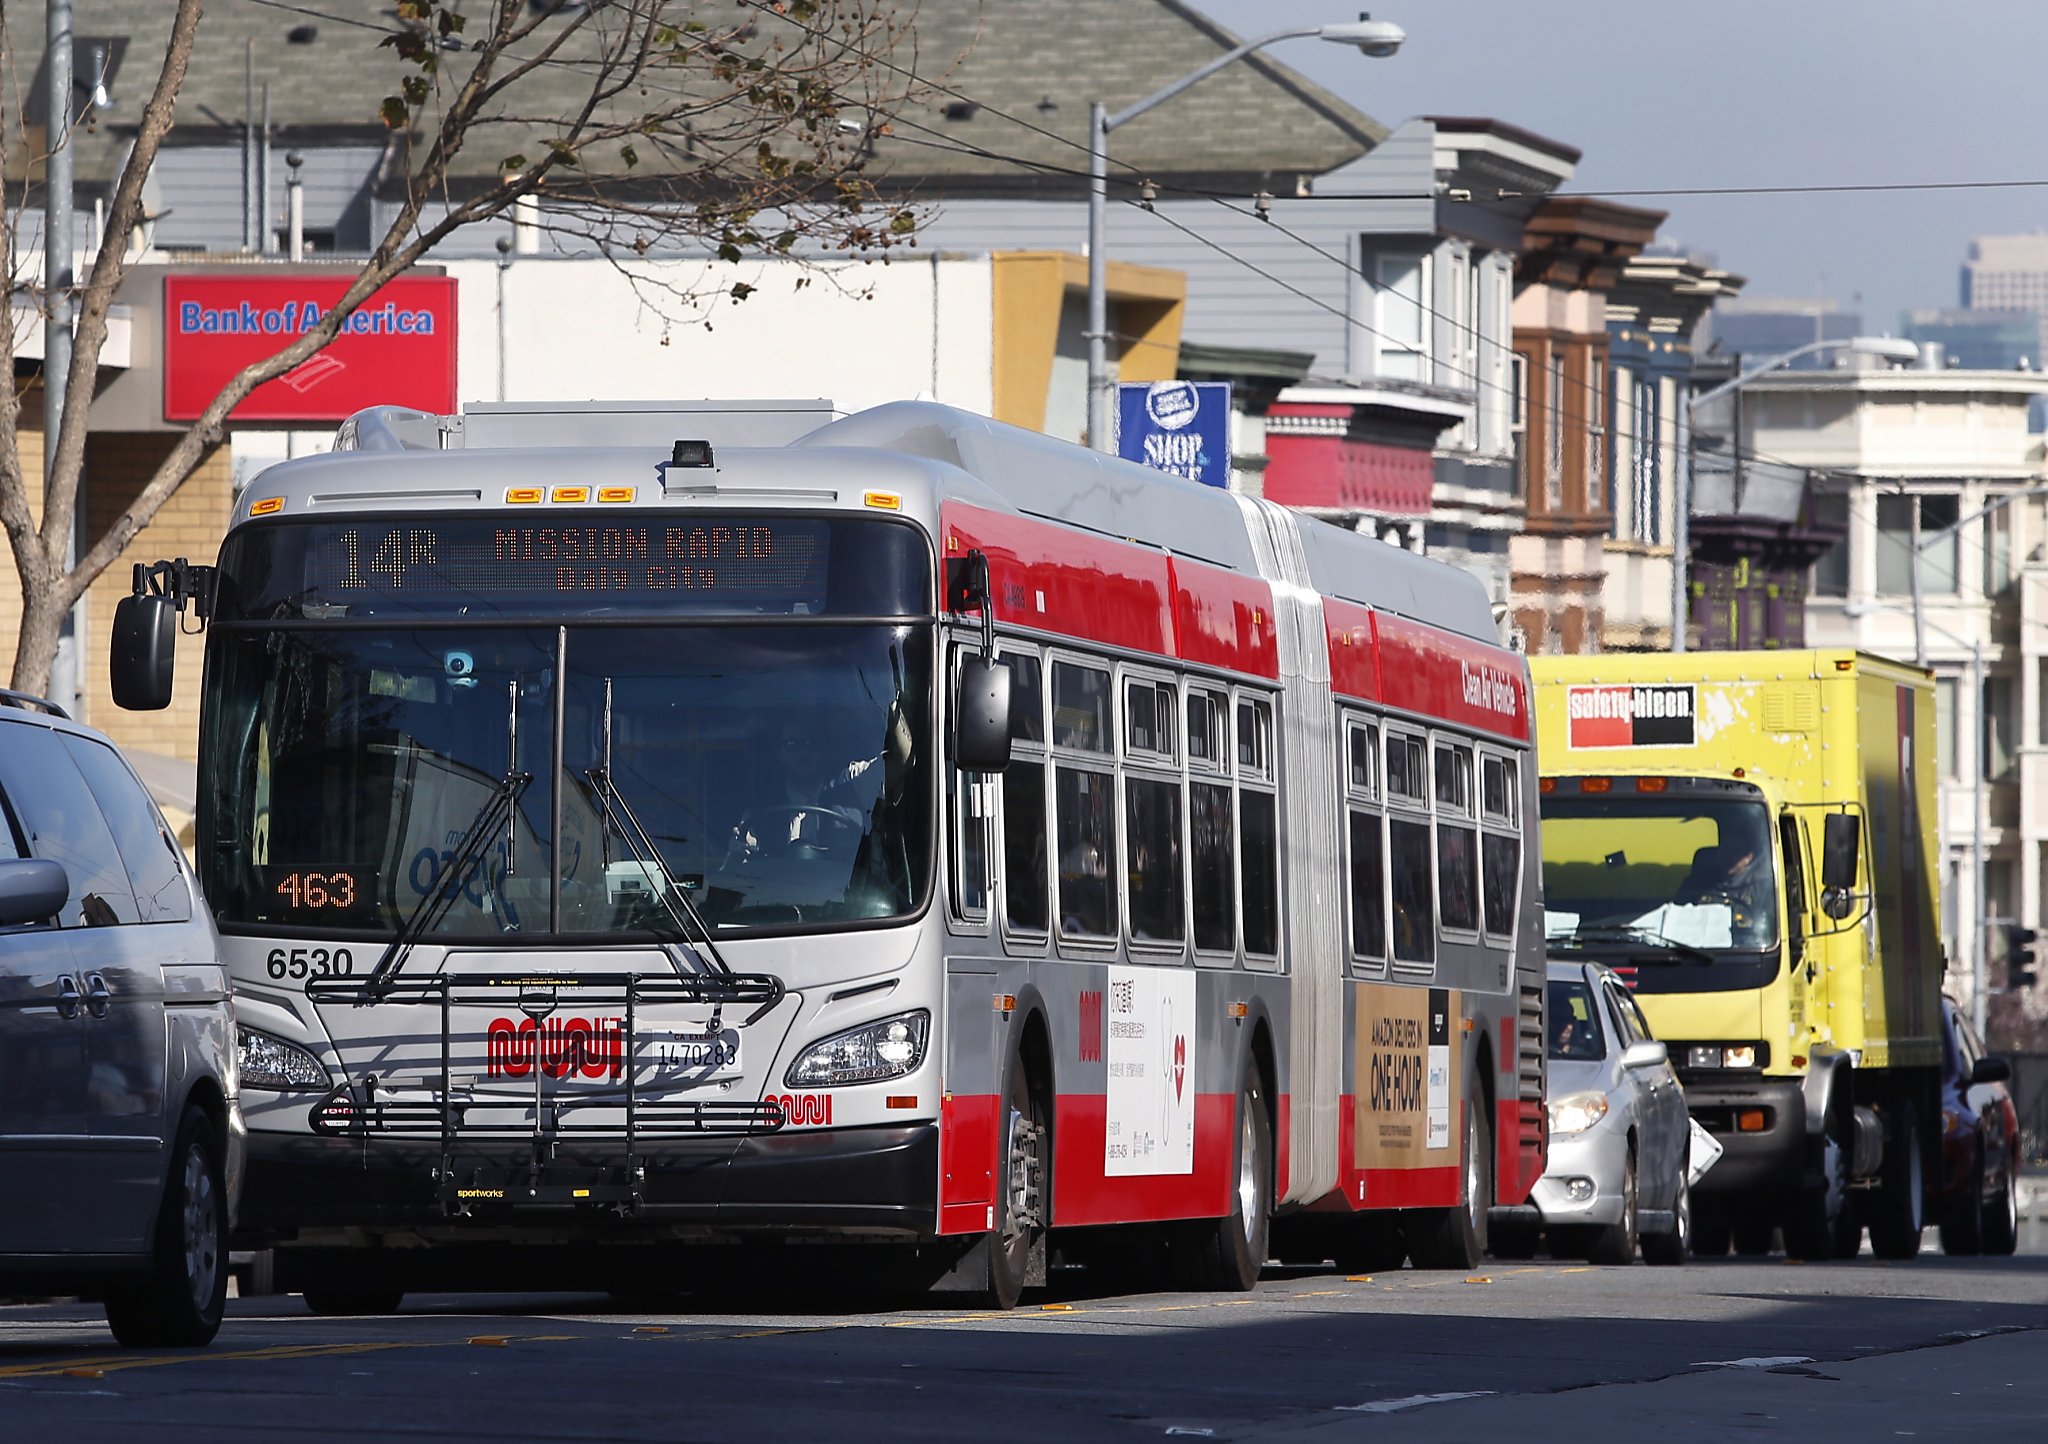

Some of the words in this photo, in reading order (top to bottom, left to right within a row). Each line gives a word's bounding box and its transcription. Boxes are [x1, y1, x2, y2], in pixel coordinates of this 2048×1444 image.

[180, 301, 260, 334] Bank
[261, 301, 296, 334] of
[299, 301, 434, 334] Aerica
[495, 527, 647, 560] MISSION
[665, 526, 772, 560] RAPID
[556, 566, 628, 590] Daly
[646, 566, 715, 589] City
[1462, 659, 1481, 707] Clean
[1481, 665, 1492, 710] Air
[1490, 668, 1516, 717] Vehicle
[278, 873, 354, 908] 463
[267, 948, 353, 979] 6530
[673, 1033, 685, 1041] CA
[689, 1033, 719, 1041] EXEMPT
[1372, 1016, 1394, 1047] AMAZON
[1394, 1018, 1416, 1049] DELIVERS
[1417, 1019, 1423, 1049] IN
[659, 1044, 736, 1066] 1470283
[1371, 1053, 1392, 1112] ONE
[1393, 1054, 1422, 1112] HOUR
[457, 1189, 503, 1198] sportworks
